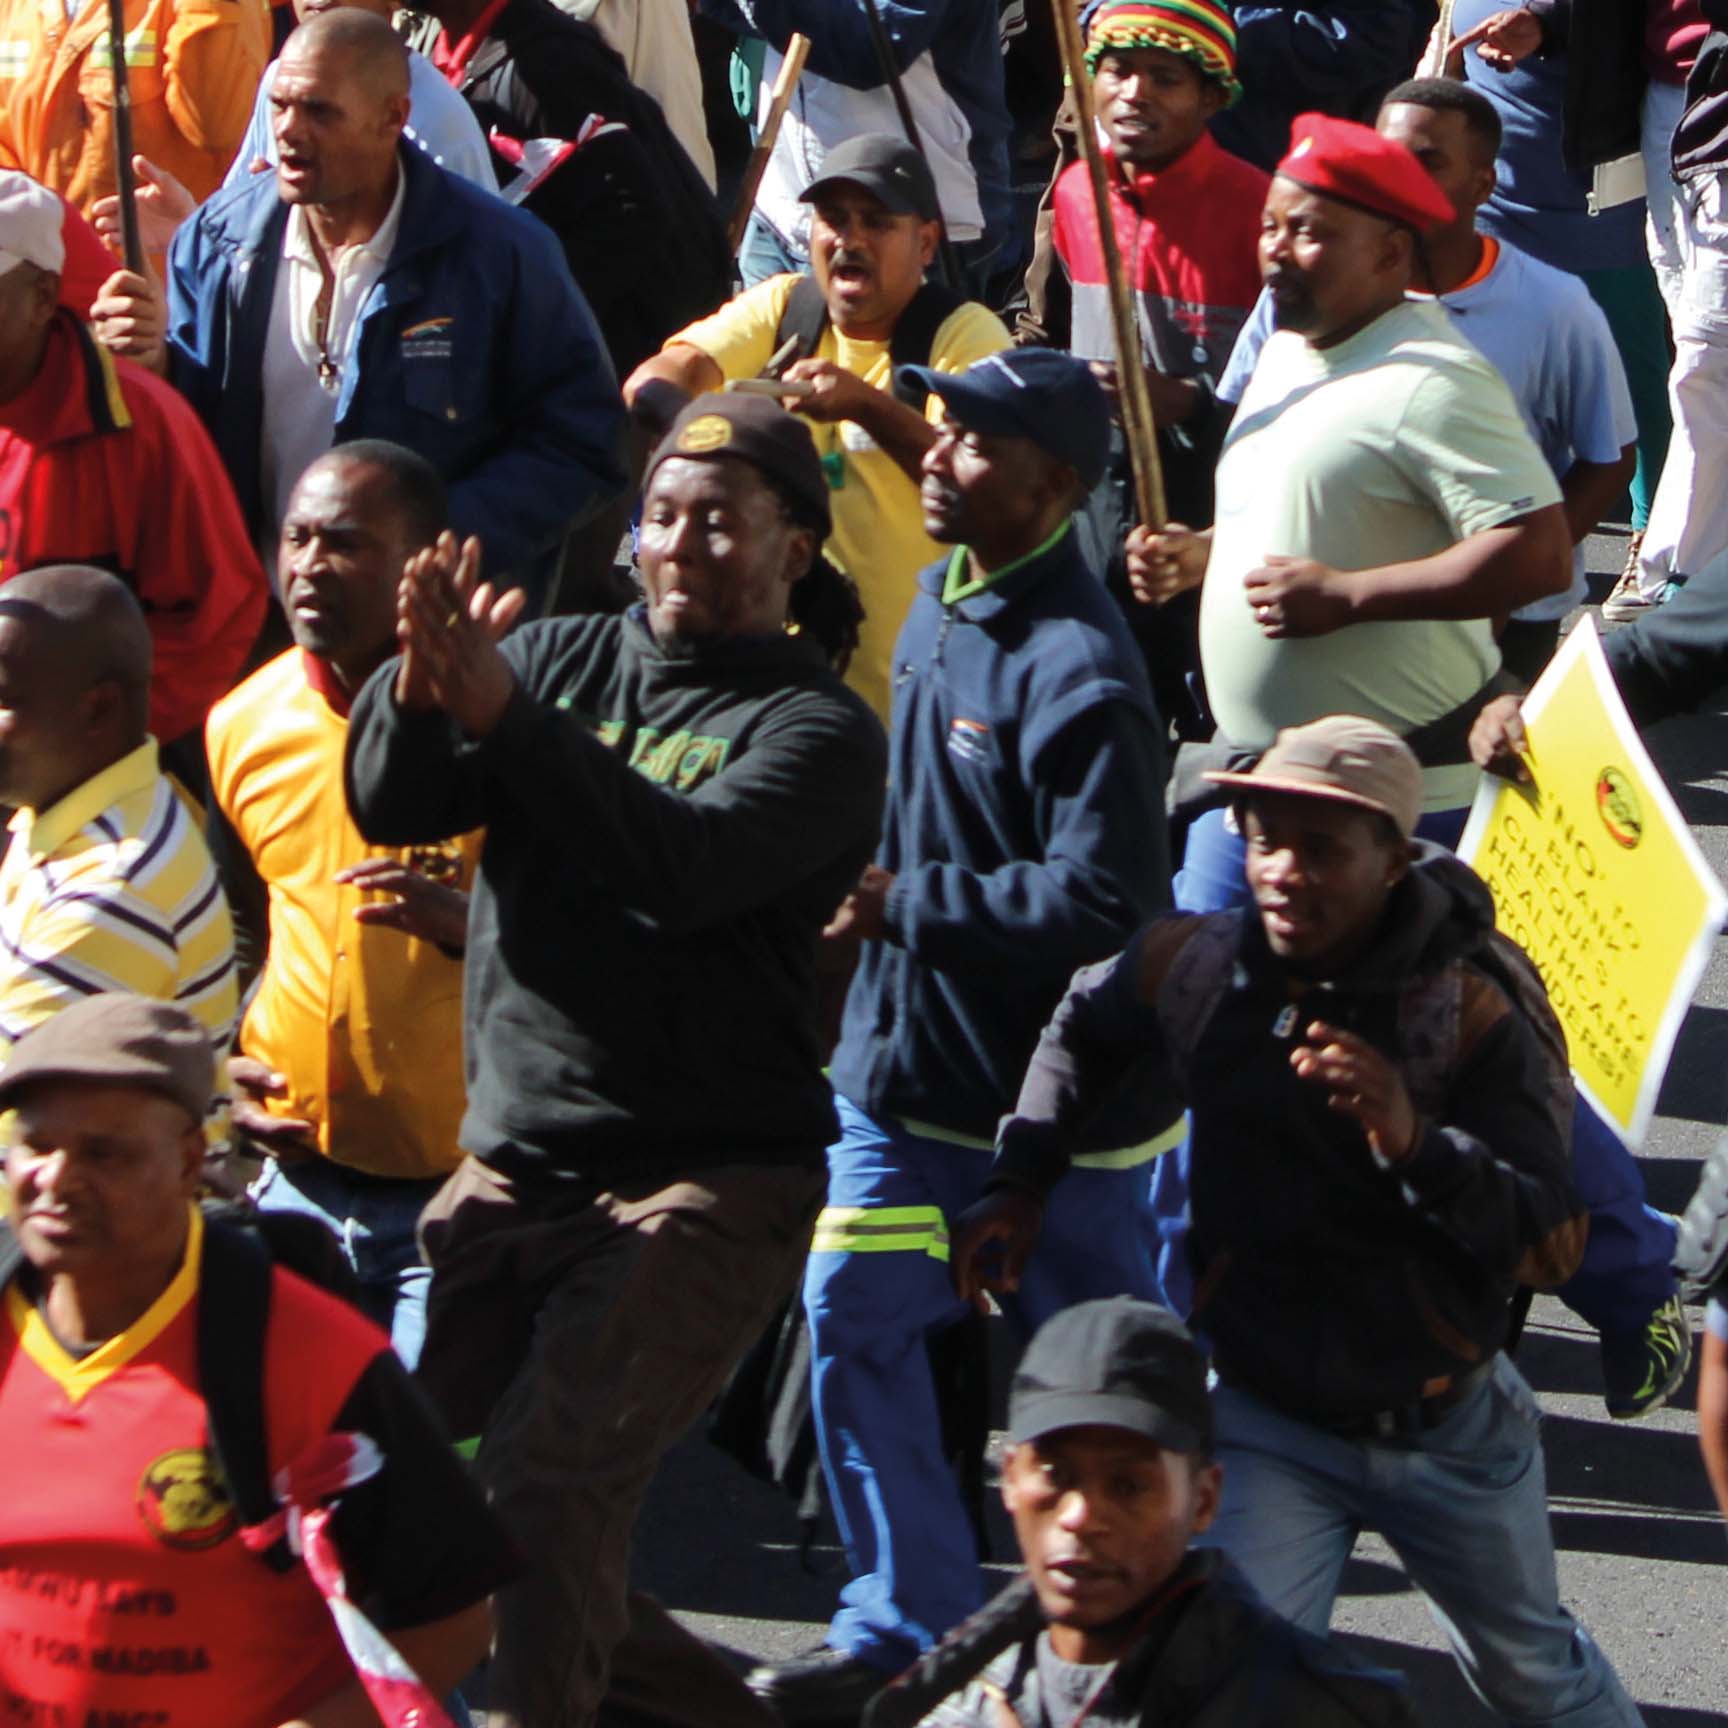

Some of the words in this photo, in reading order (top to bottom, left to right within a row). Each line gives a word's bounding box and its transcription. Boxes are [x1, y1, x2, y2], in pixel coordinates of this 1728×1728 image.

[1488, 835, 1636, 1075] HEALTHCARE
[1503, 815, 1608, 987] CHEQUES
[1619, 998, 1646, 1043] TO
[1546, 840, 1622, 953] BLANK
[1612, 905, 1640, 951] TO
